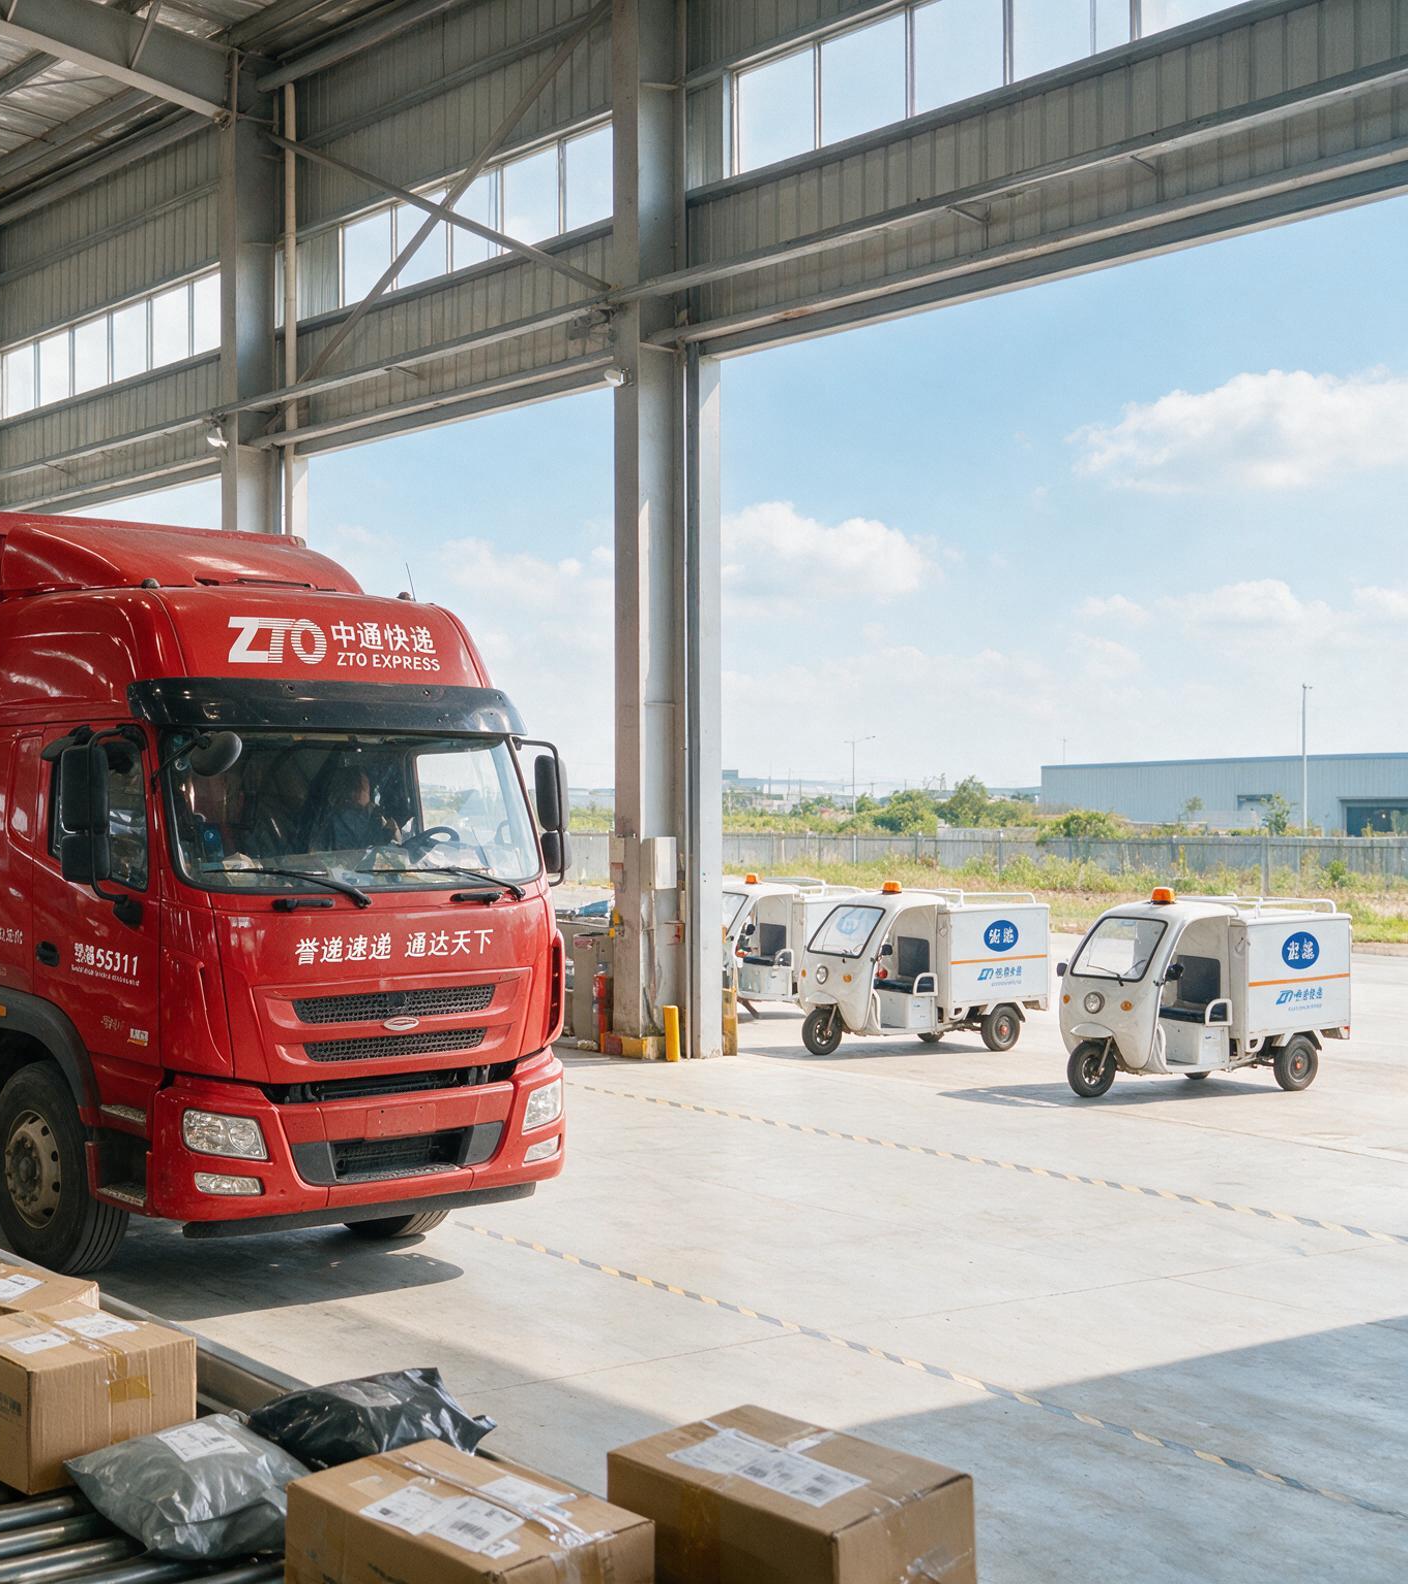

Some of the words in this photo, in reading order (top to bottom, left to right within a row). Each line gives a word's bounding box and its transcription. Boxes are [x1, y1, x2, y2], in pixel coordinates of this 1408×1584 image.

[227, 616, 327, 665] ZTO
[330, 620, 437, 654] 中通快递
[336, 651, 367, 667] ZTO
[372, 654, 441, 671] EXPRESS
[294, 932, 392, 966] 誉递速递
[404, 928, 494, 958] 通达天下
